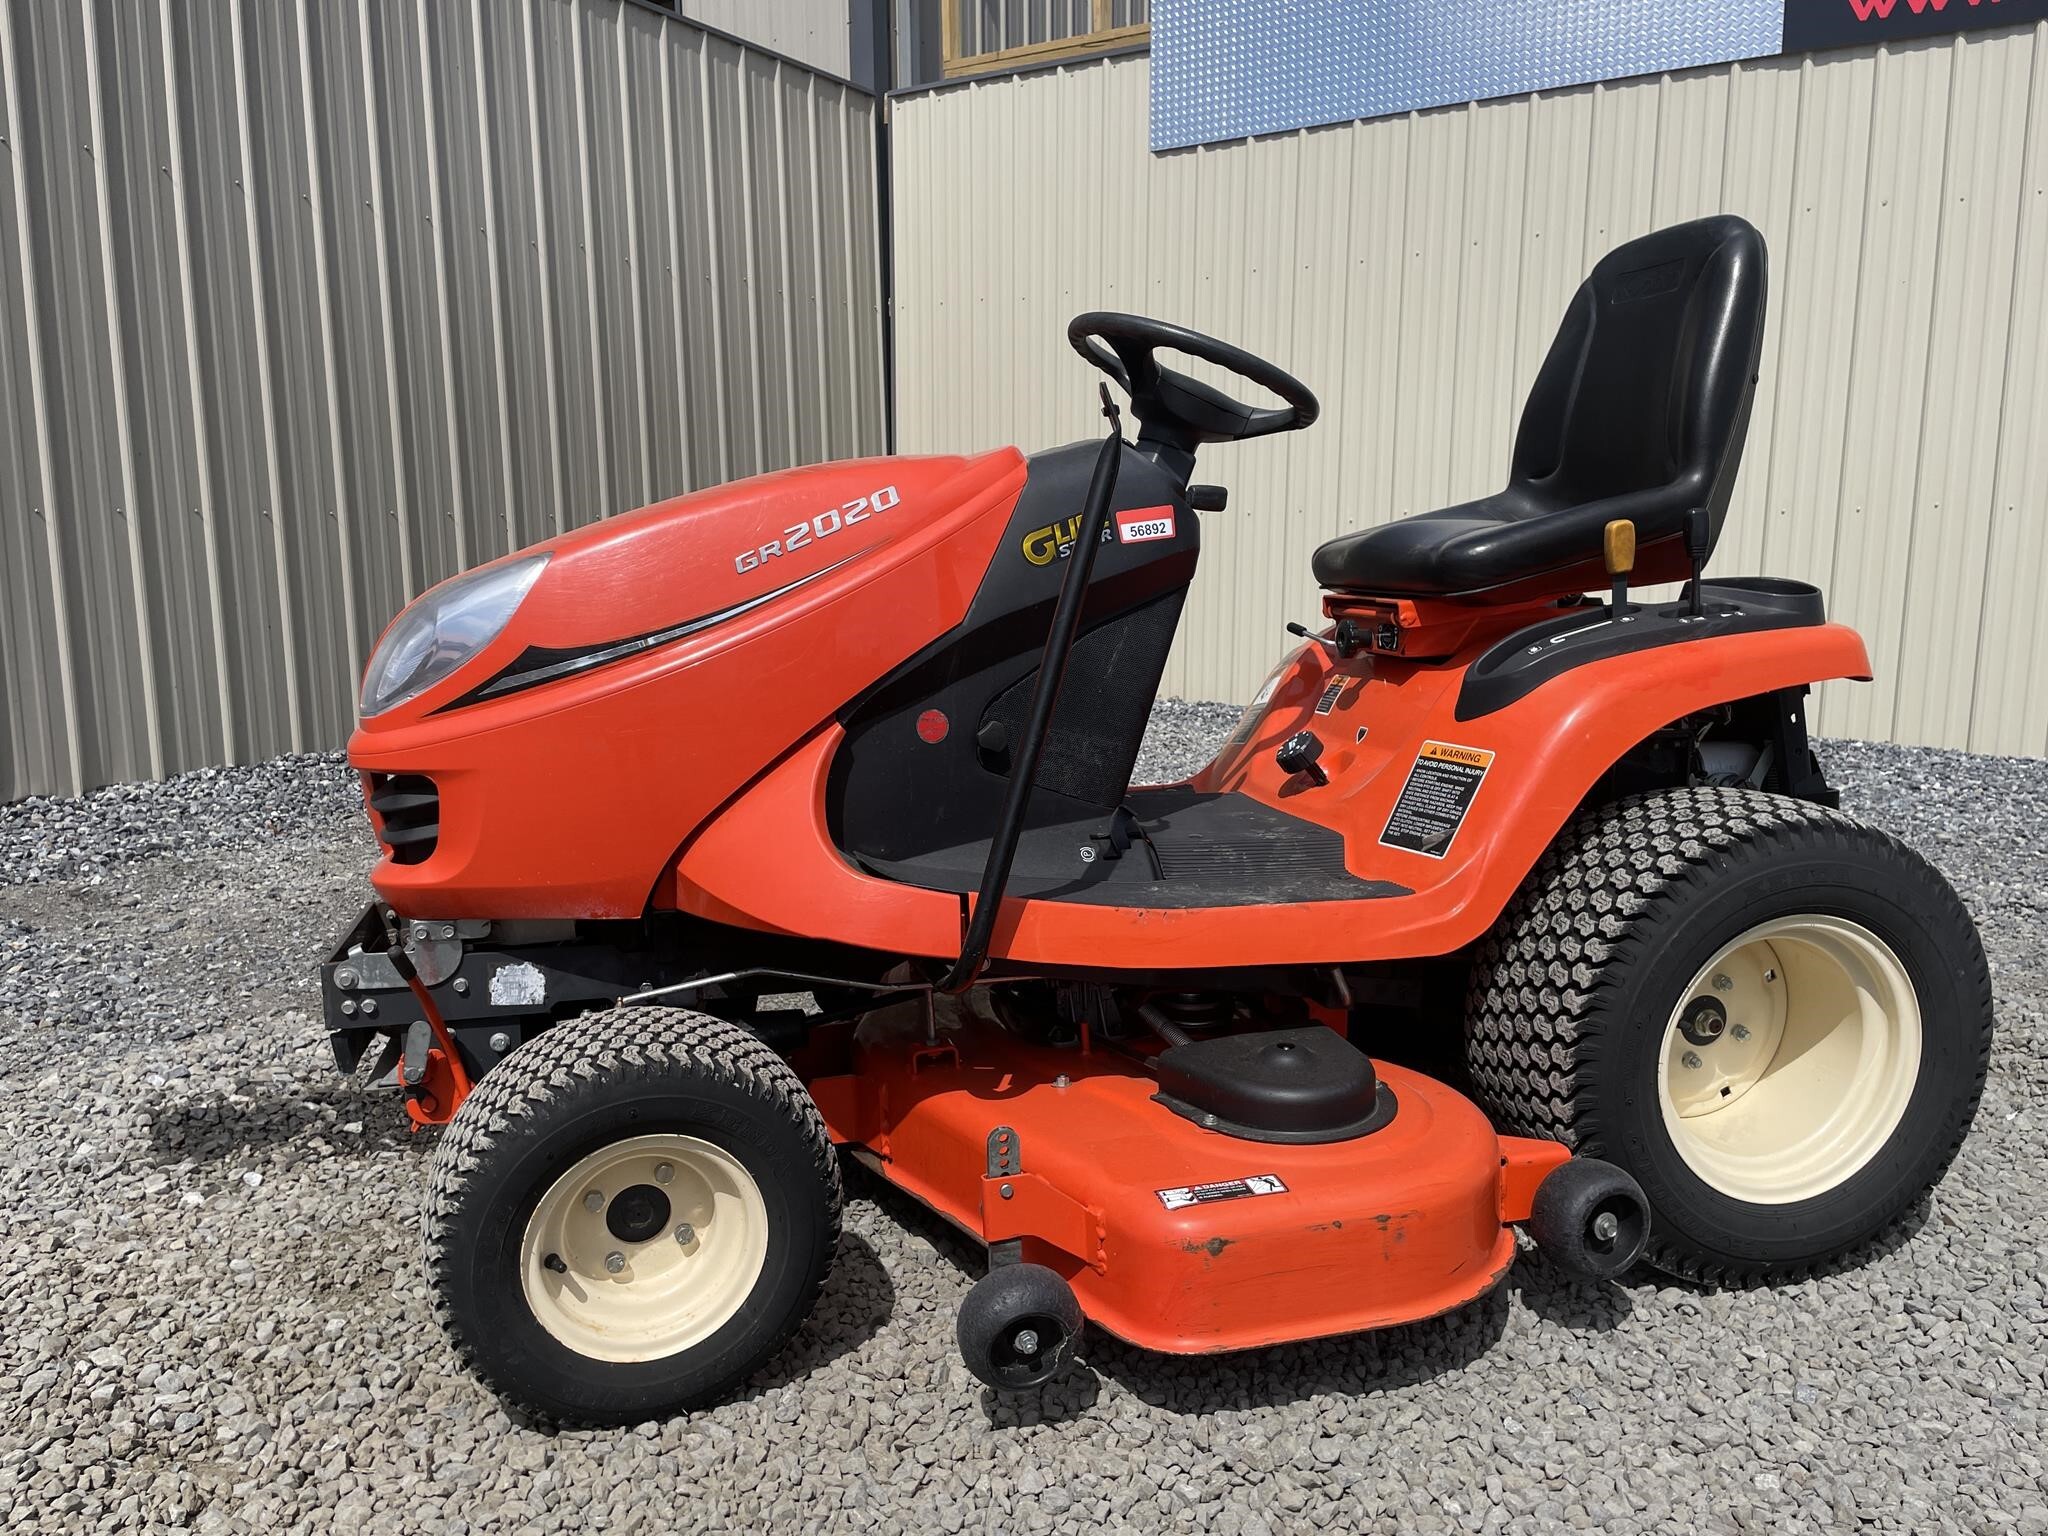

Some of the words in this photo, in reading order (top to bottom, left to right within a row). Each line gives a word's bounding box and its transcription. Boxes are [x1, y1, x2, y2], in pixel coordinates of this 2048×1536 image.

[735, 486, 900, 574] GR2020
[1130, 522, 1167, 538] 56892
[1023, 514, 1110, 565] GLI
[1440, 748, 1482, 762] WARNING
[1423, 759, 1438, 767] AVOID
[1438, 762, 1464, 772] PERSONAL
[1465, 767, 1484, 776] INJURY
[1202, 1180, 1242, 1190] DANGER
